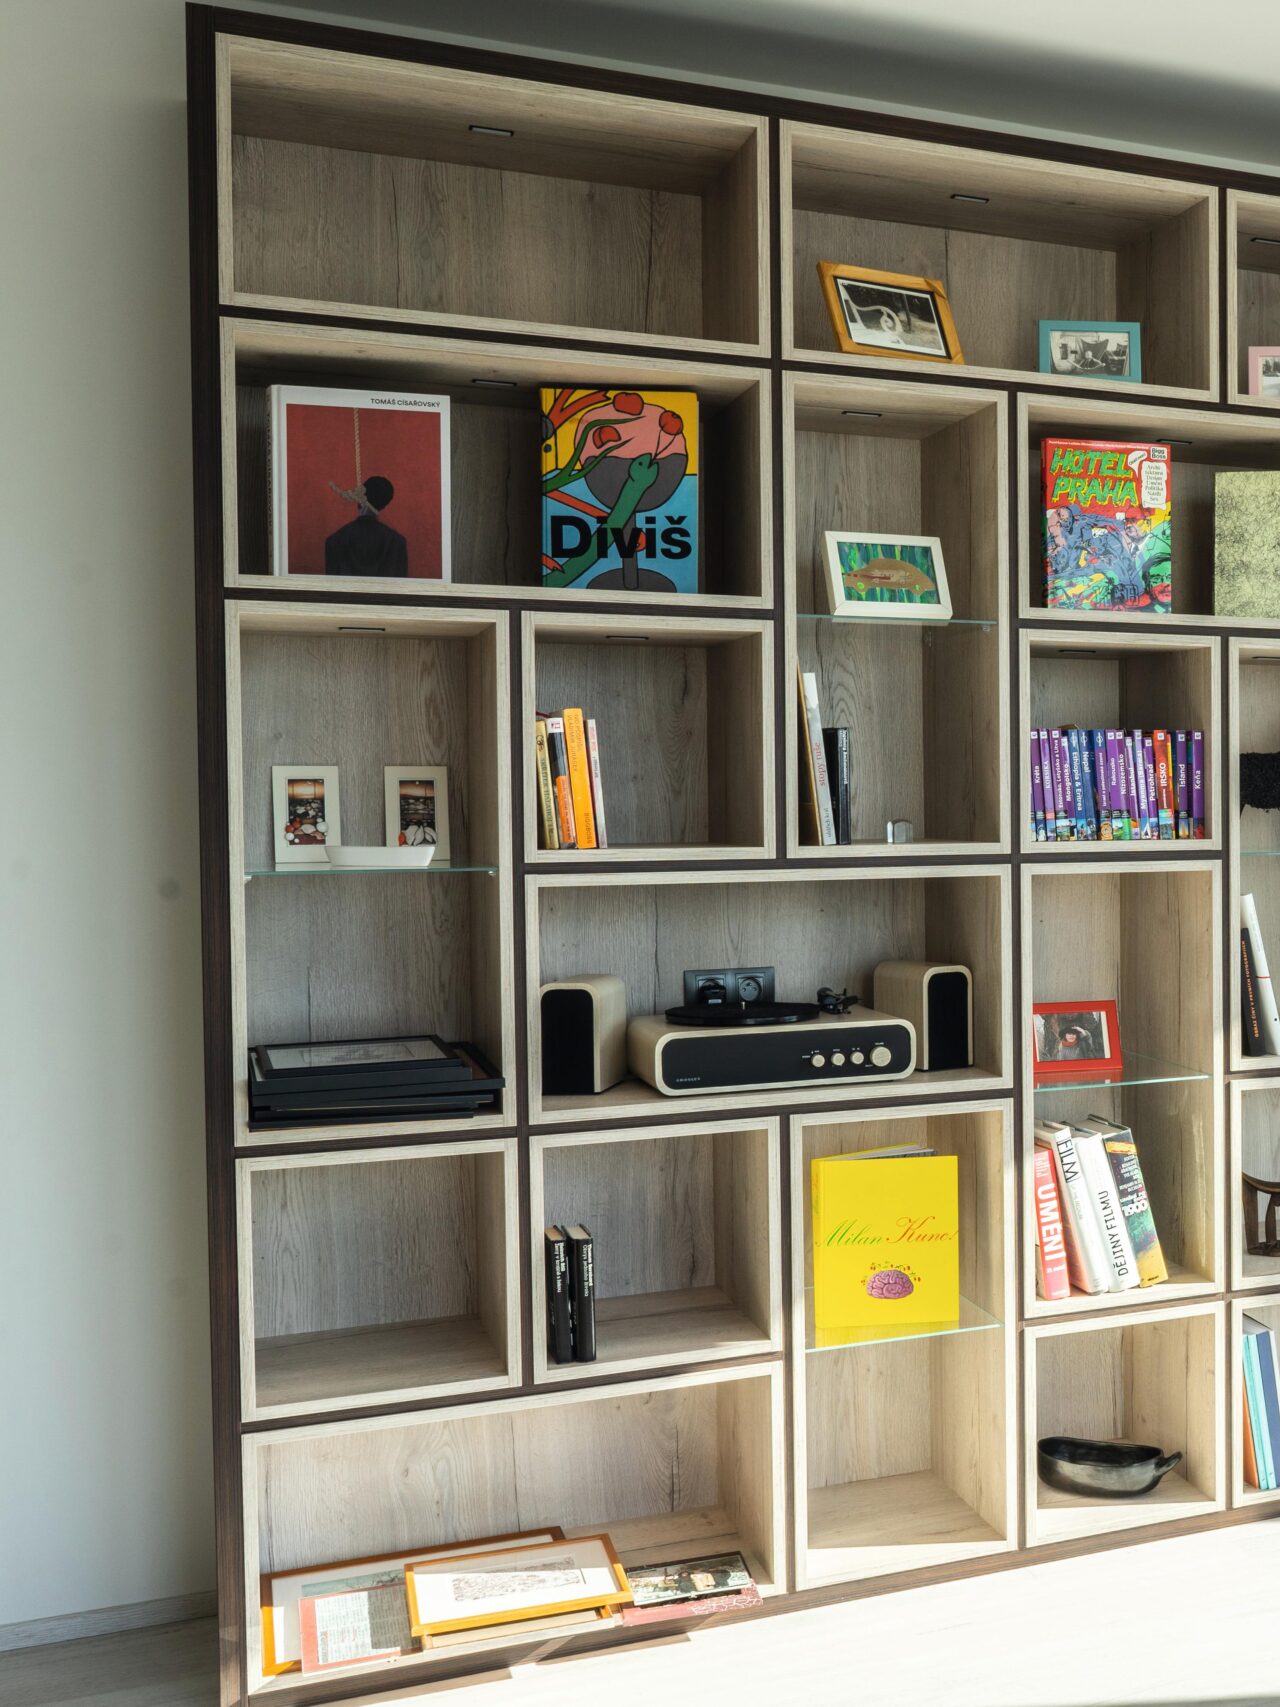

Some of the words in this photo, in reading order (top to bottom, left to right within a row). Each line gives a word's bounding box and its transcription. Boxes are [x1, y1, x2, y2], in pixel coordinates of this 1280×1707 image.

[1050, 447, 1133, 479] HOTEL
[1051, 475, 1139, 508] PRAHA
[550, 515, 692, 560] Diviš
[1043, 761, 1051, 789] KORSIKA
[1072, 752, 1080, 780] Ethiopia
[1082, 751, 1091, 773] Nepal
[1118, 753, 1127, 795] Nizozemsko
[1159, 762, 1168, 787] IRSKO
[1178, 763, 1186, 788] Island
[1064, 763, 1072, 802] Mongolsko
[1147, 763, 1156, 801] Petrohrad
[1056, 1138, 1080, 1184] FILM
[1036, 1182, 1067, 1261] UMĚNÍ
[1097, 1189, 1119, 1231] FILMU
[815, 1218, 882, 1248] Milan
[1107, 1233, 1129, 1277] DĚJINY
